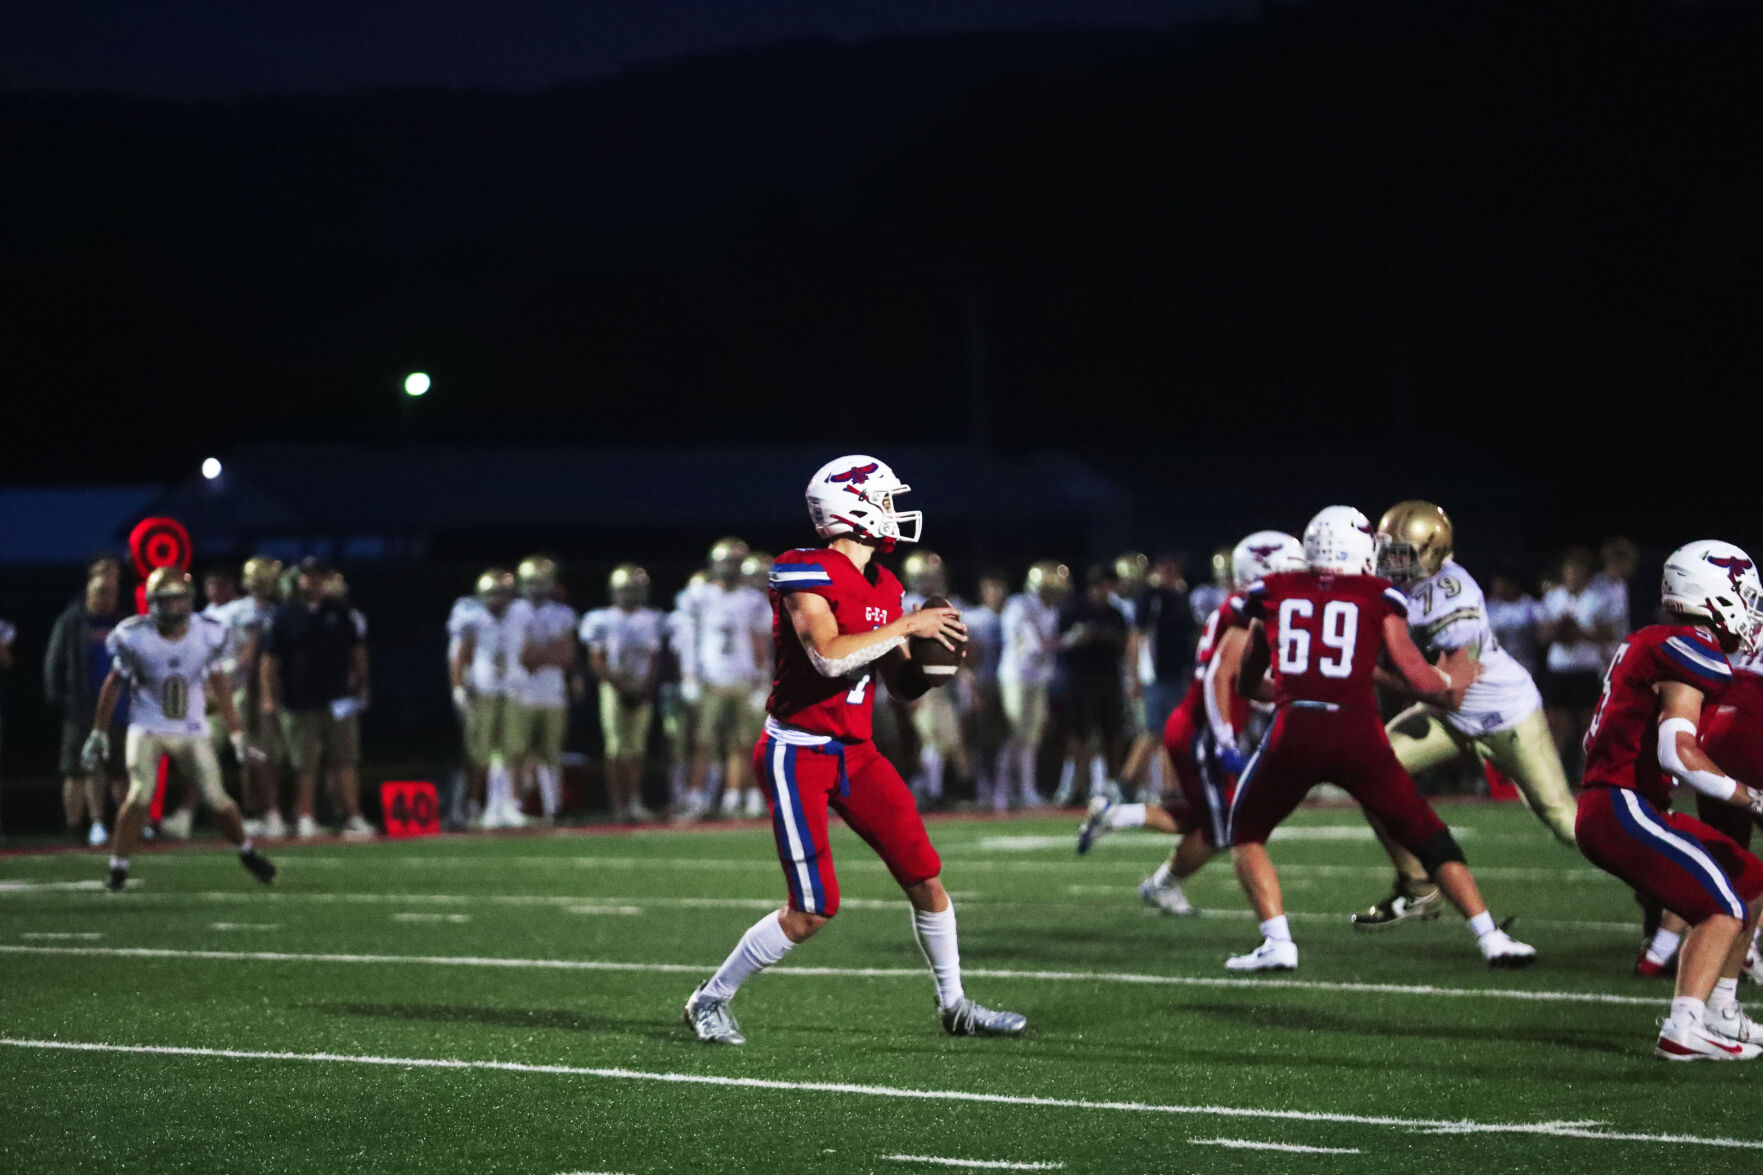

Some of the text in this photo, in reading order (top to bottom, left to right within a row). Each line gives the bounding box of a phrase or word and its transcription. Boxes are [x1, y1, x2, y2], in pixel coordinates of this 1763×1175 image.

[1411, 577, 1462, 617] 79
[1277, 598, 1360, 679] 69
[162, 673, 188, 721] 0
[391, 793, 438, 828] 40
